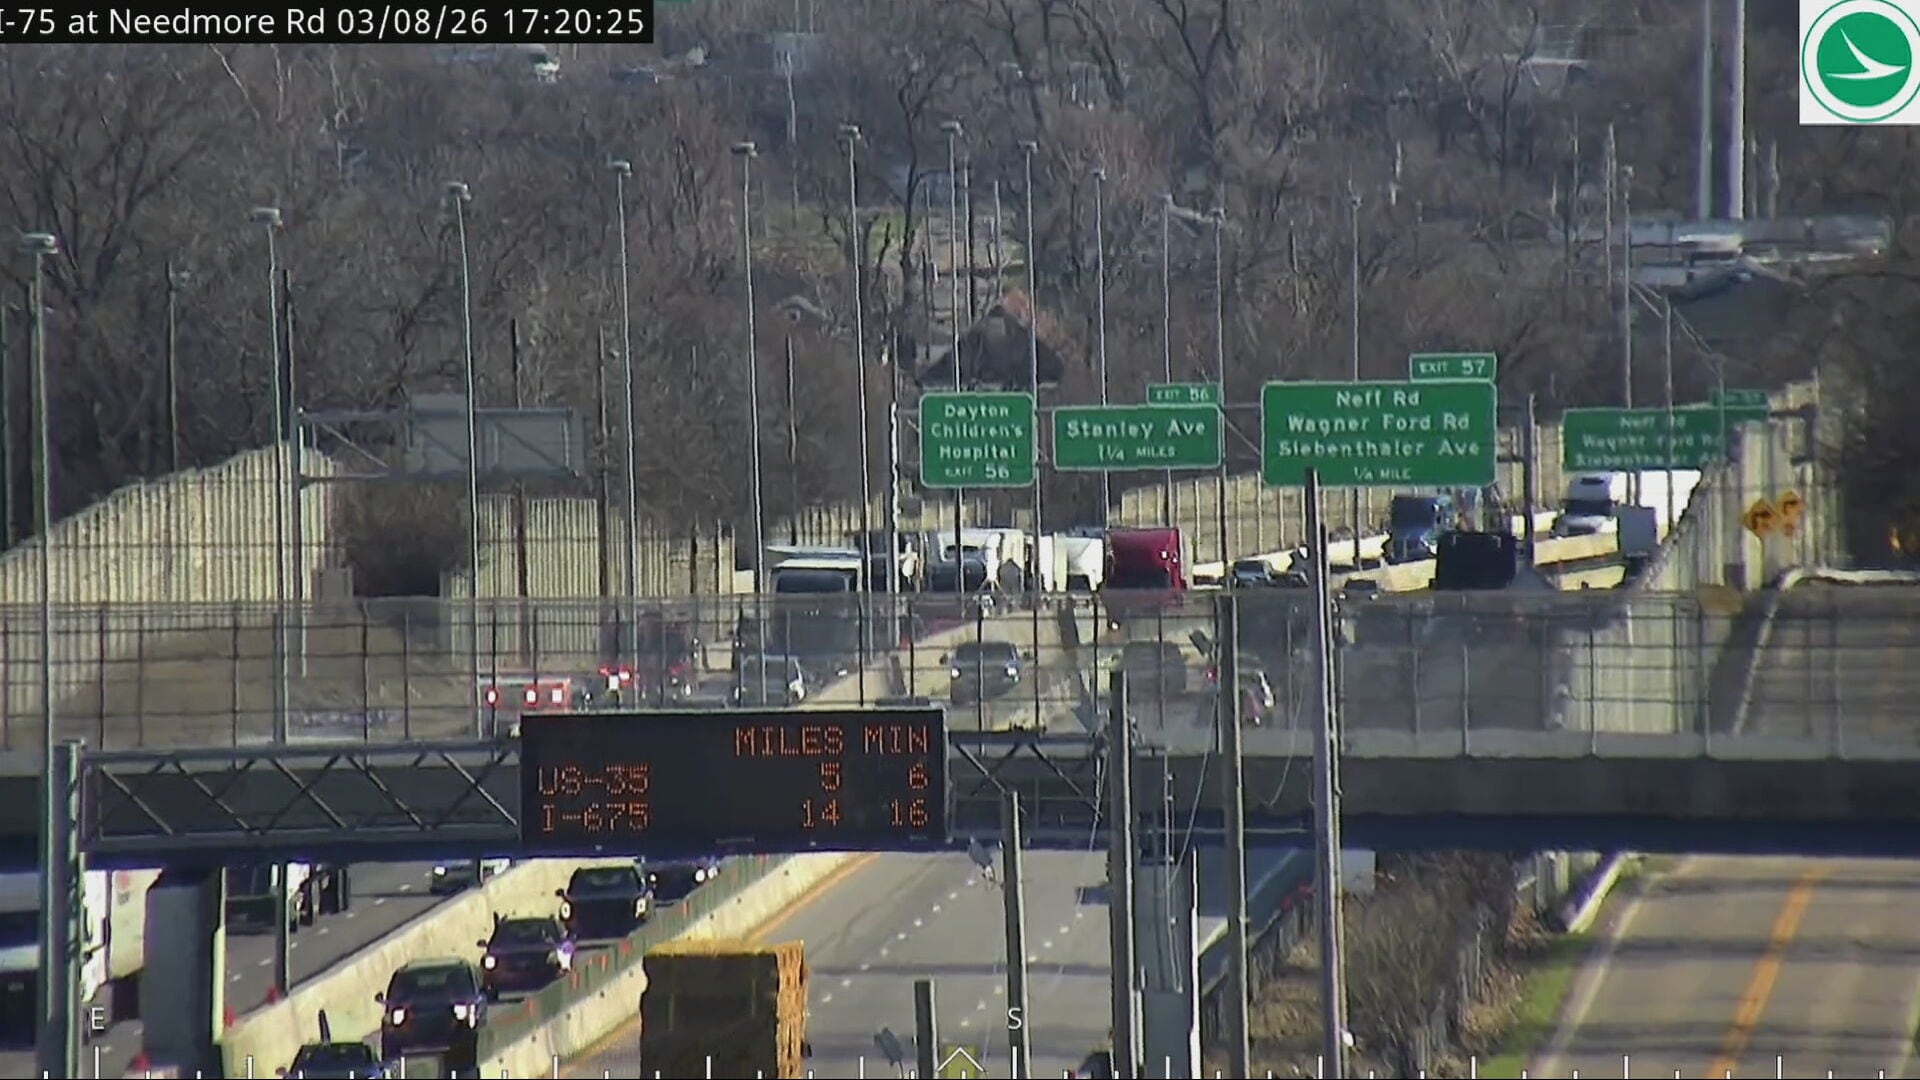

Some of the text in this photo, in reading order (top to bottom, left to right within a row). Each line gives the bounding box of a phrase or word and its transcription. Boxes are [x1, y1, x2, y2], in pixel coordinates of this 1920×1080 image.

[1419, 359, 1486, 375] EXIT 57
[1189, 386, 1210, 401] 56
[1336, 389, 1421, 407] Neff Rd
[944, 403, 1010, 421] Dayton
[931, 420, 1024, 438] Children's
[1066, 419, 1206, 439] Stanley Ave
[1287, 412, 1470, 437] Wagner Ford Rd
[938, 442, 1018, 462] Hospital
[1136, 446, 1176, 458] MILES
[1278, 438, 1480, 458] Siebenthaler Ave
[984, 463, 1010, 479] 56
[1380, 467, 1412, 480] MILE
[735, 724, 929, 757] MILES MIN
[537, 762, 929, 796] US-35 5 6
[541, 799, 929, 832] I-675 14 16
